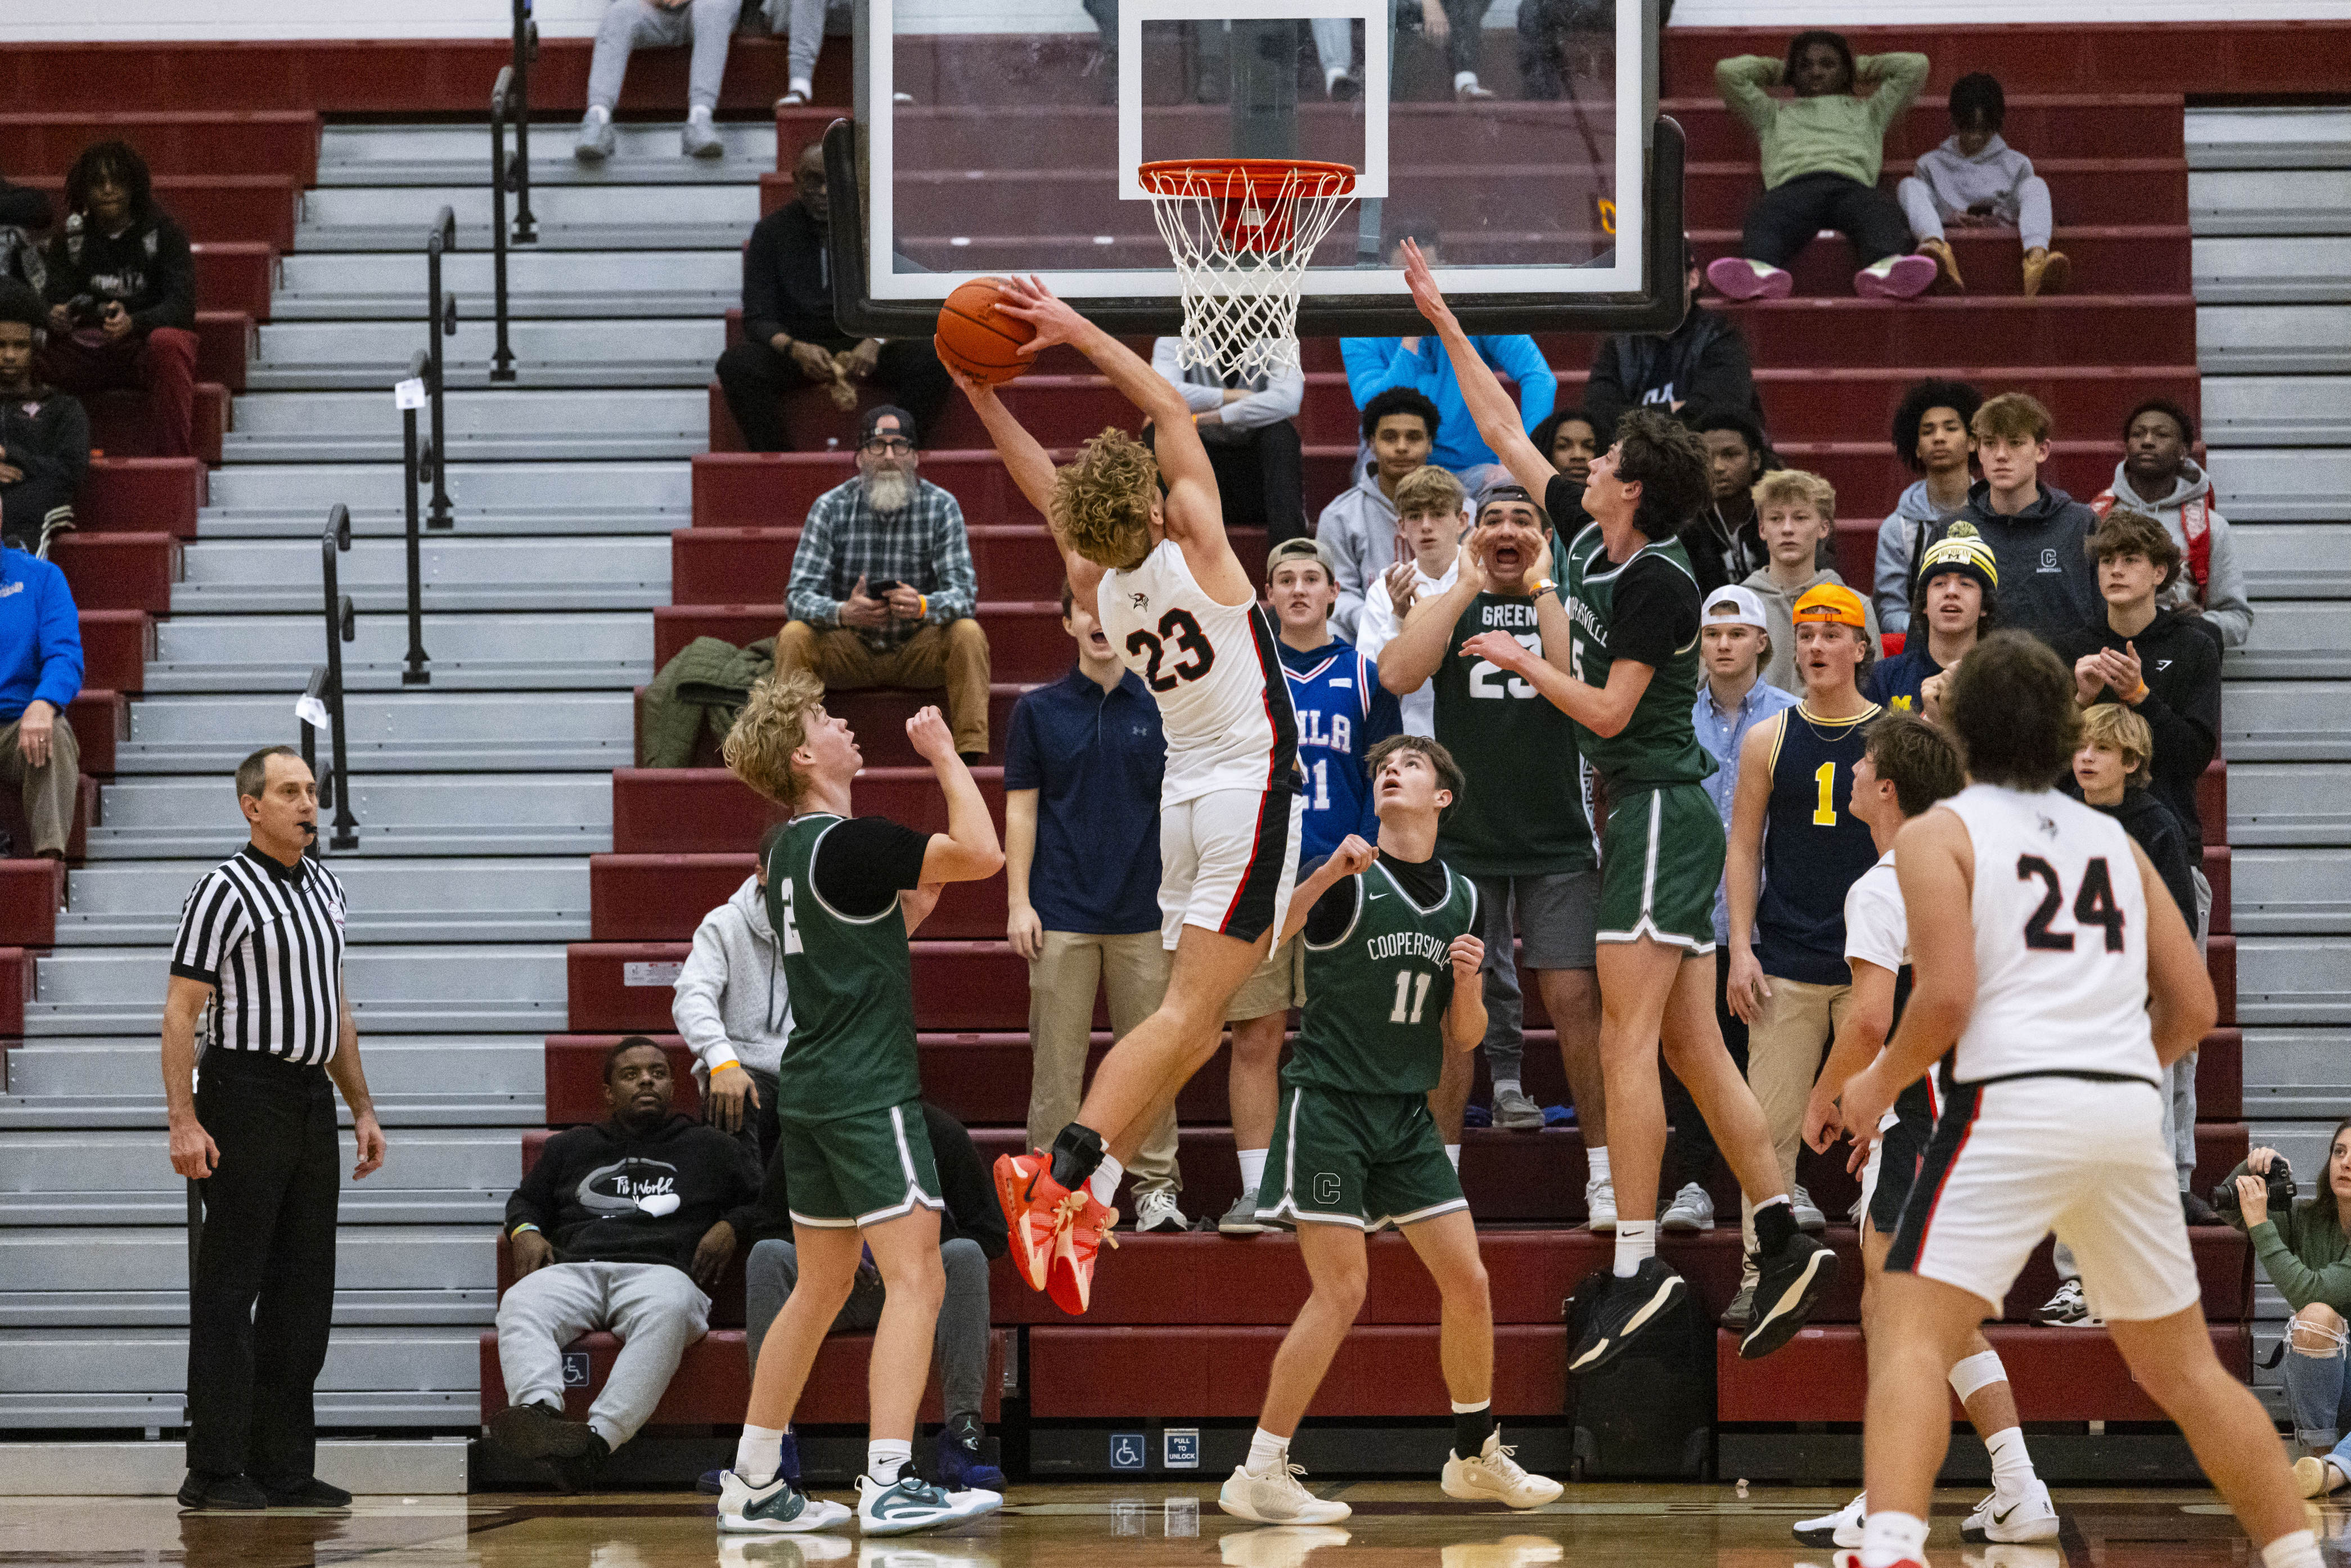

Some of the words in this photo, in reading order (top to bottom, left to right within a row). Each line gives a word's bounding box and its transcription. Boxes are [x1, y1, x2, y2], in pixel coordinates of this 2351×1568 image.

[2041, 548, 2057, 567] C
[1481, 603, 1538, 627] GREEN
[1125, 607, 1215, 692] 23
[1891, 695, 1912, 711] M
[1813, 762, 1837, 826] 1
[781, 877, 804, 954] 2
[2016, 853, 2126, 954] 24
[1389, 969, 1432, 1025] 11
[1313, 1172, 1341, 1204] C
